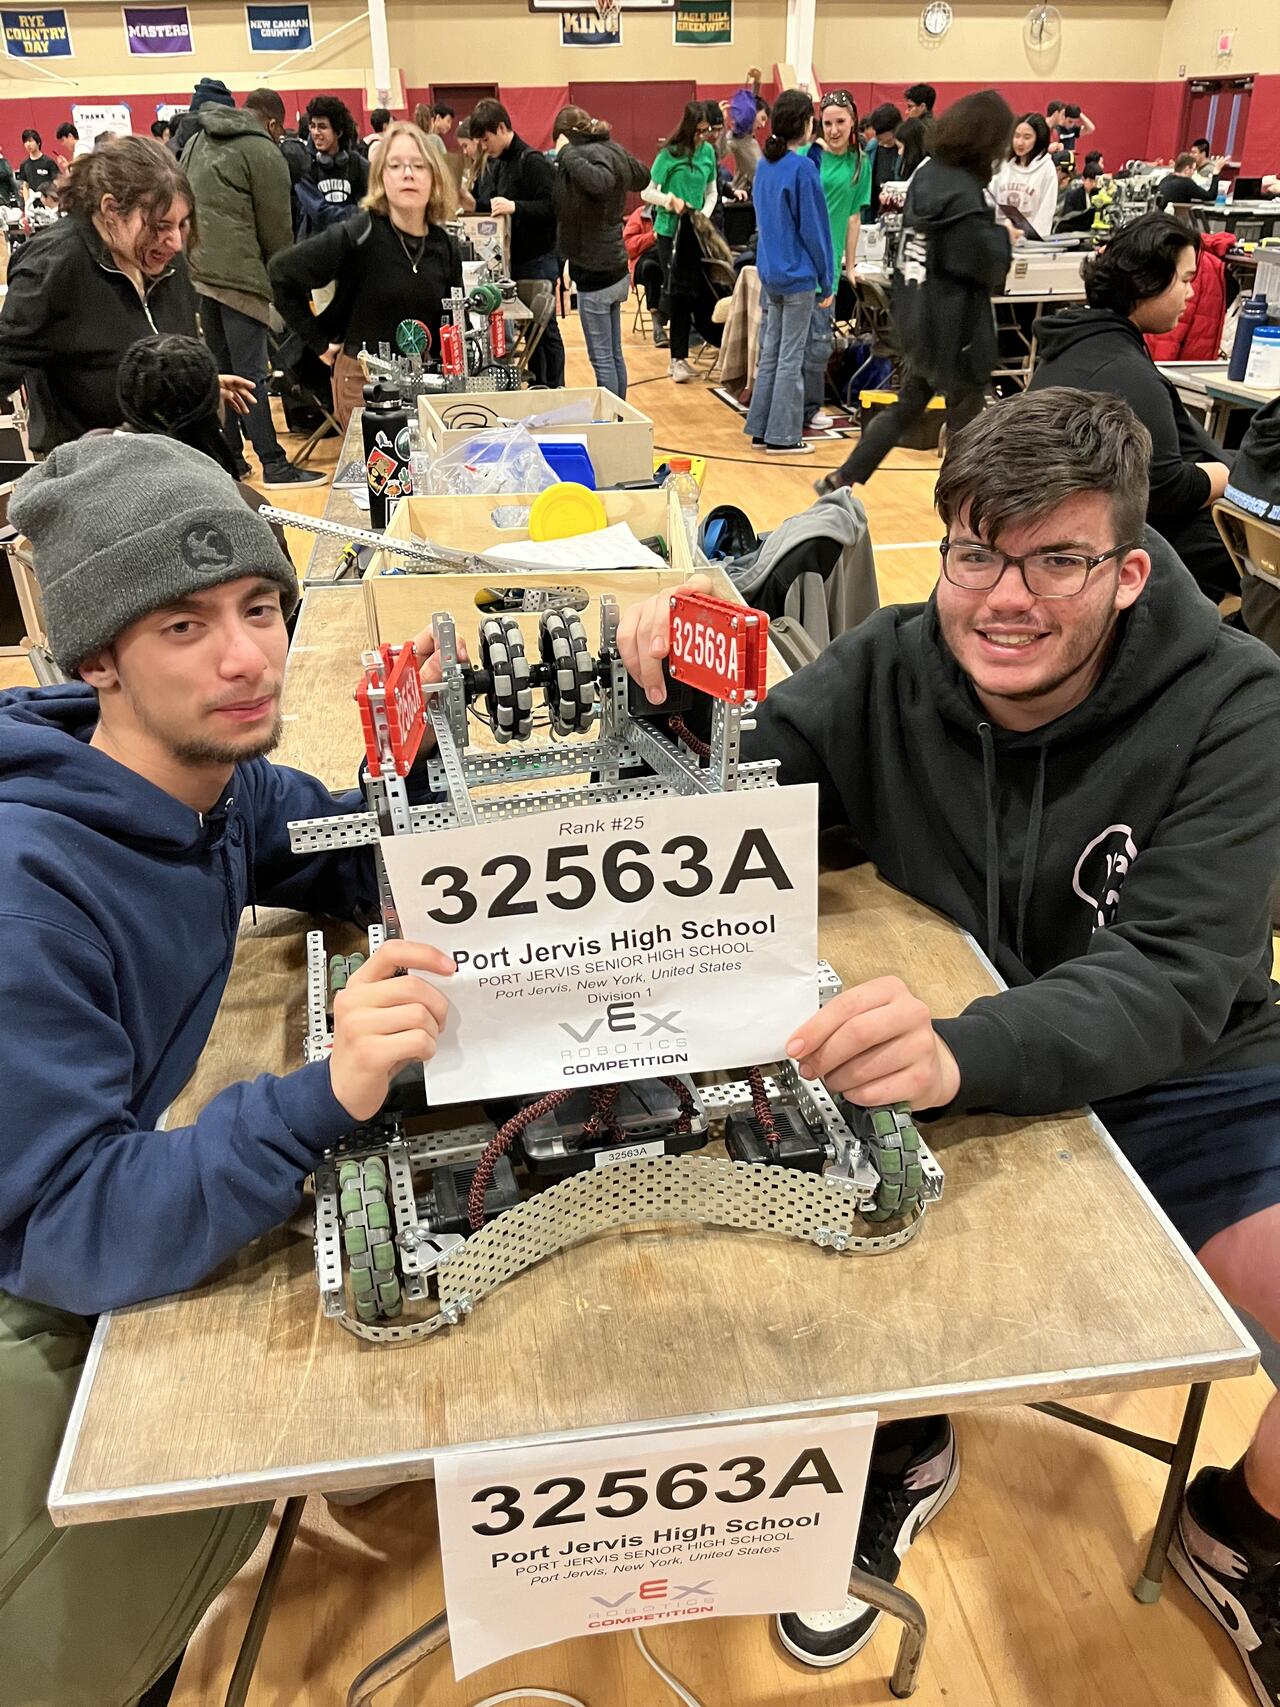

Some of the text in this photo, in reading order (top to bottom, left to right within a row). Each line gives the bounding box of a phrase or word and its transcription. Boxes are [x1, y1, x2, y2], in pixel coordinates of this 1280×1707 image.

[18, 15, 46, 28] RYE
[250, 19, 309, 29] NEW CANAAN
[563, 13, 619, 33] KING
[677, 12, 729, 22] EAGLE HILL
[677, 21, 730, 32] GREENWICH
[6, 27, 66, 40] COUNTRY
[128, 24, 189, 38] MASTERS
[260, 28, 300, 37] COUNTRY
[23, 41, 49, 53] DAY
[673, 616, 738, 682] 32563A
[559, 815, 645, 836] Rank #25
[421, 828, 794, 924] 32563A
[453, 914, 776, 973] Port Jervis High School
[478, 942, 755, 988] PORT JERVIS SENIOR HIGH SCHOOL
[496, 961, 742, 999] Port Jervis, New York, United States
[588, 988, 652, 1004] Division 1
[558, 1001, 686, 1043] VEX
[560, 1038, 688, 1060] ROBOTICS
[562, 1053, 689, 1076] COMPETITION
[608, 1147, 647, 1161] 32563A
[471, 1447, 844, 1536] 32563A
[491, 1512, 820, 1568] Port Jervis High School
[516, 1532, 795, 1577] PORT JERVIS SENIOR HIGH SCHOOL
[530, 1546, 781, 1586] Port Jervis, New York, United States
[590, 1579, 718, 1608] VEX
[588, 1599, 715, 1619] ROBOTICS
[588, 1606, 715, 1629] COMPETITION
